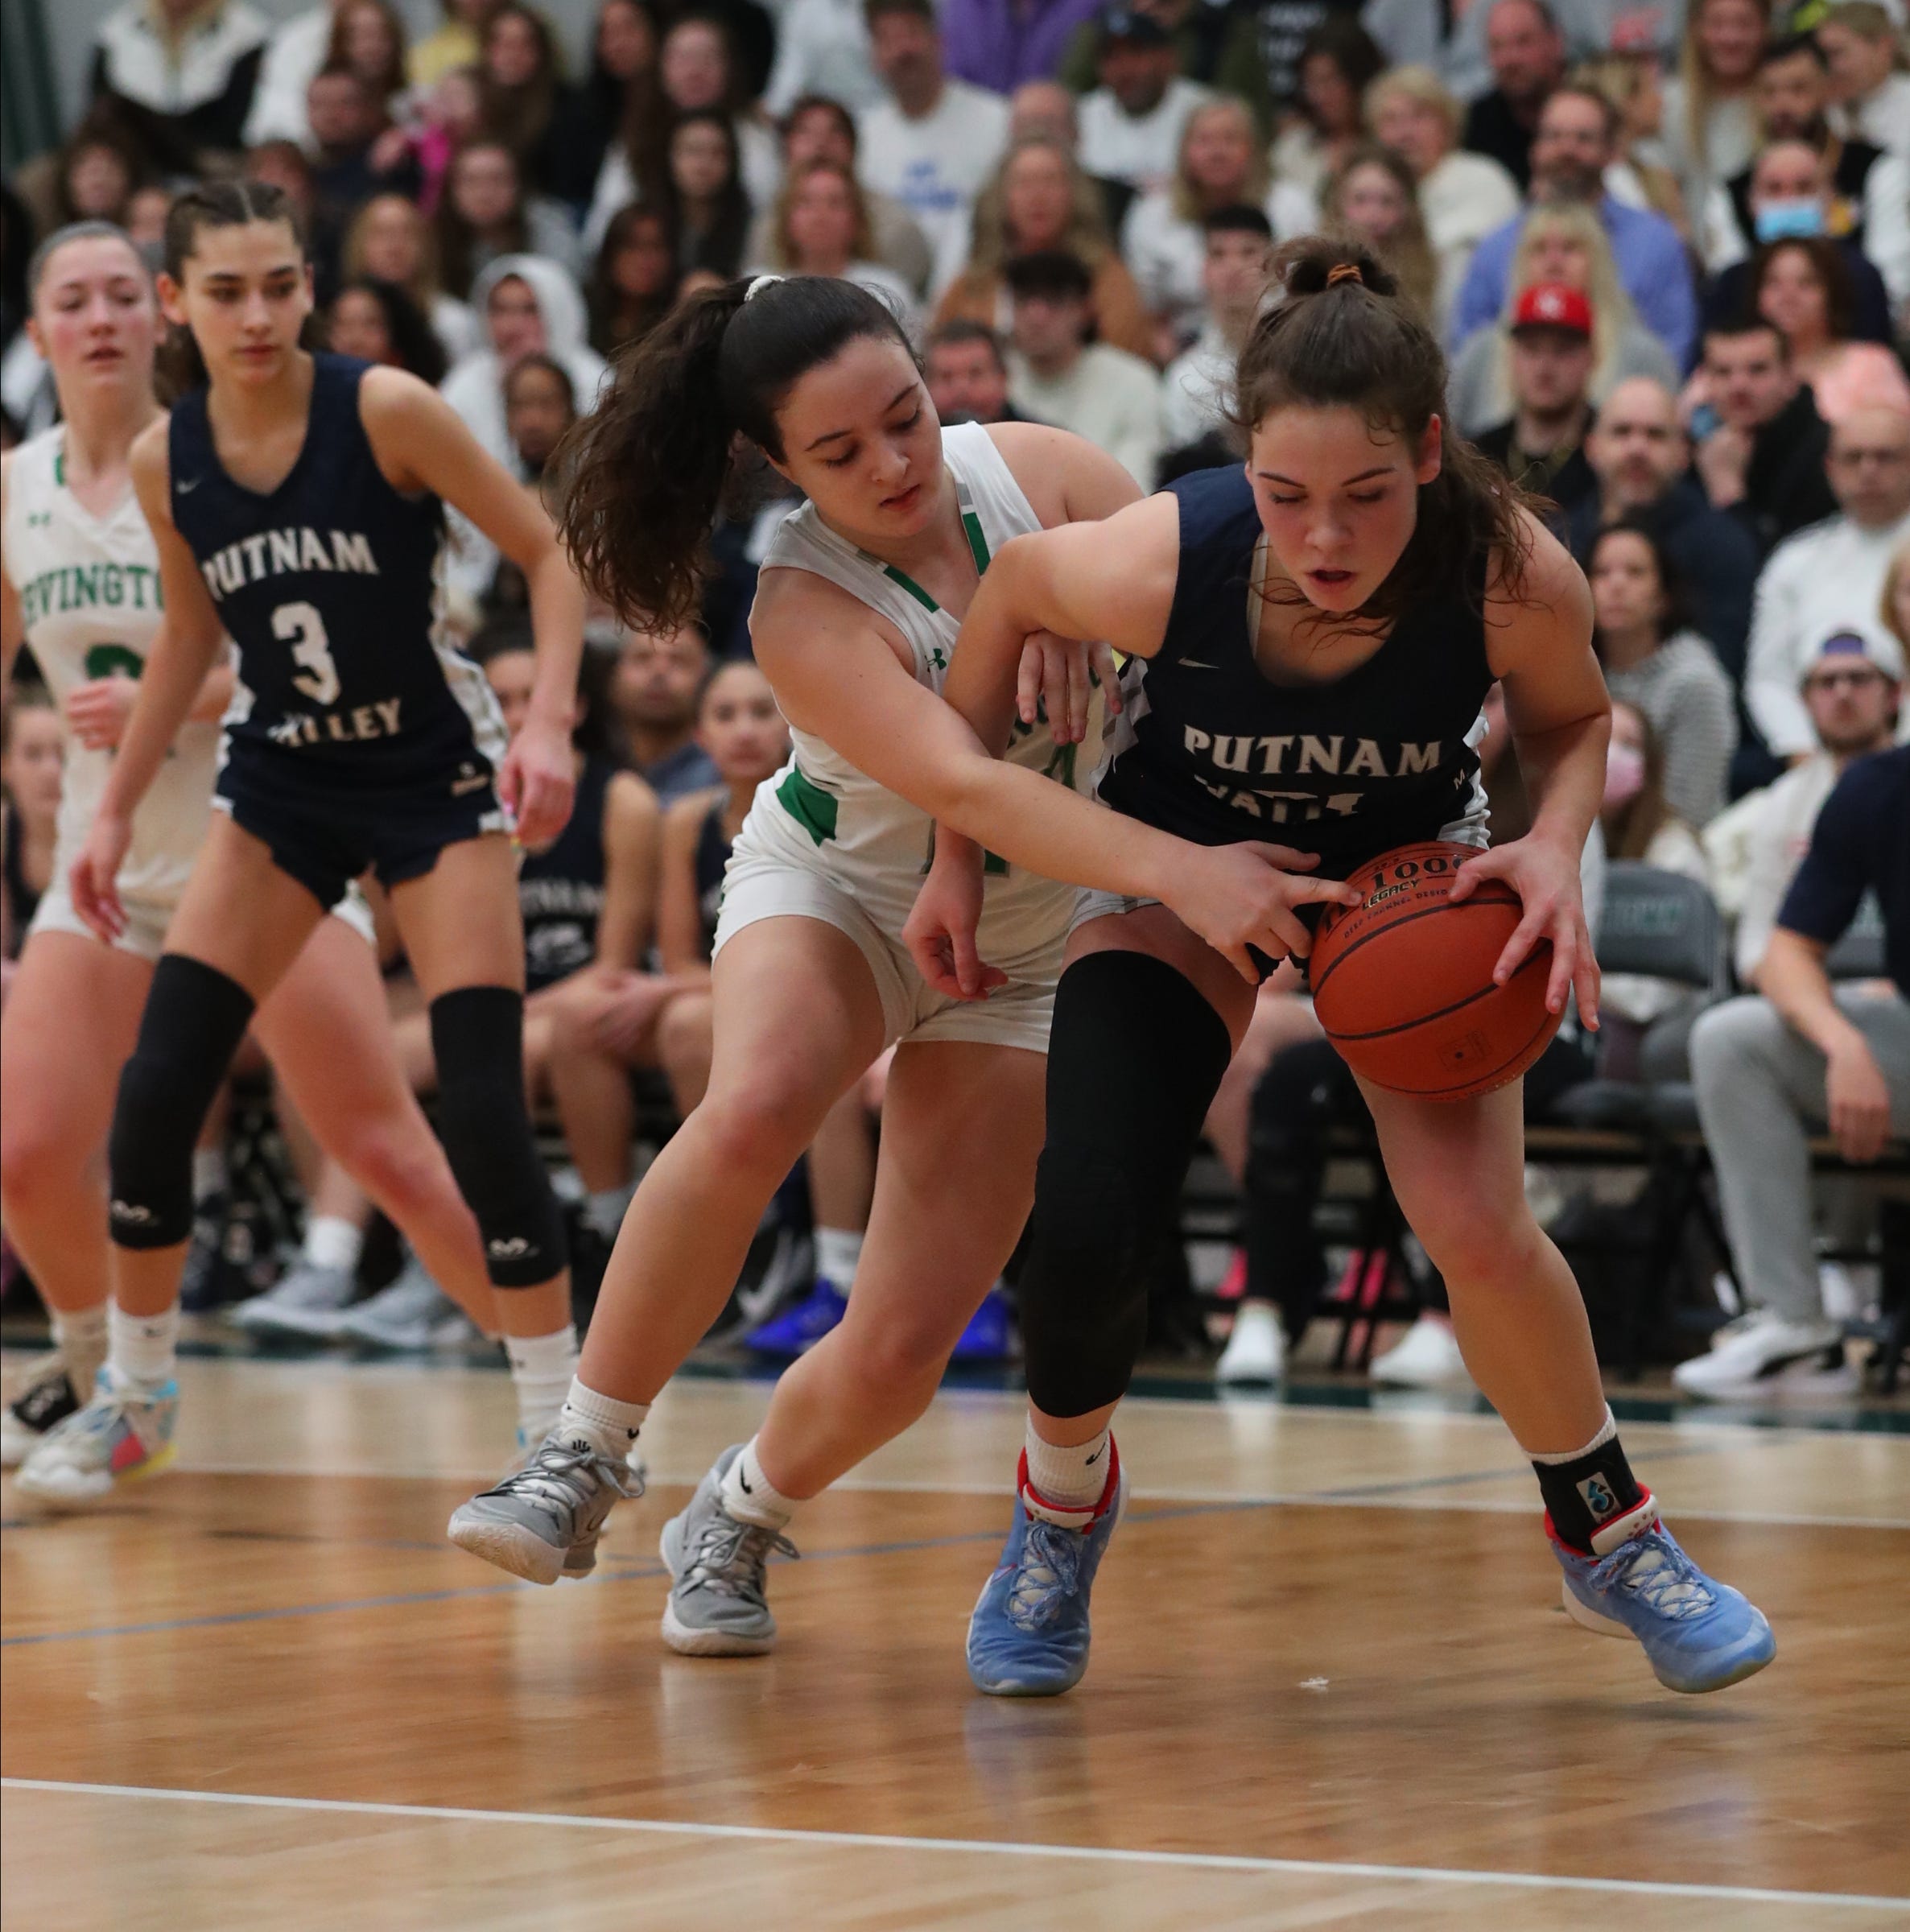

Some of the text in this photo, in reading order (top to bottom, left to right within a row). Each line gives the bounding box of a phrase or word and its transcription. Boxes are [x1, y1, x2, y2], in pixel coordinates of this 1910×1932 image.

[270, 601, 340, 705] 3
[1184, 724, 1442, 777] PUTNAM
[1362, 877, 1422, 911] LEGACY
